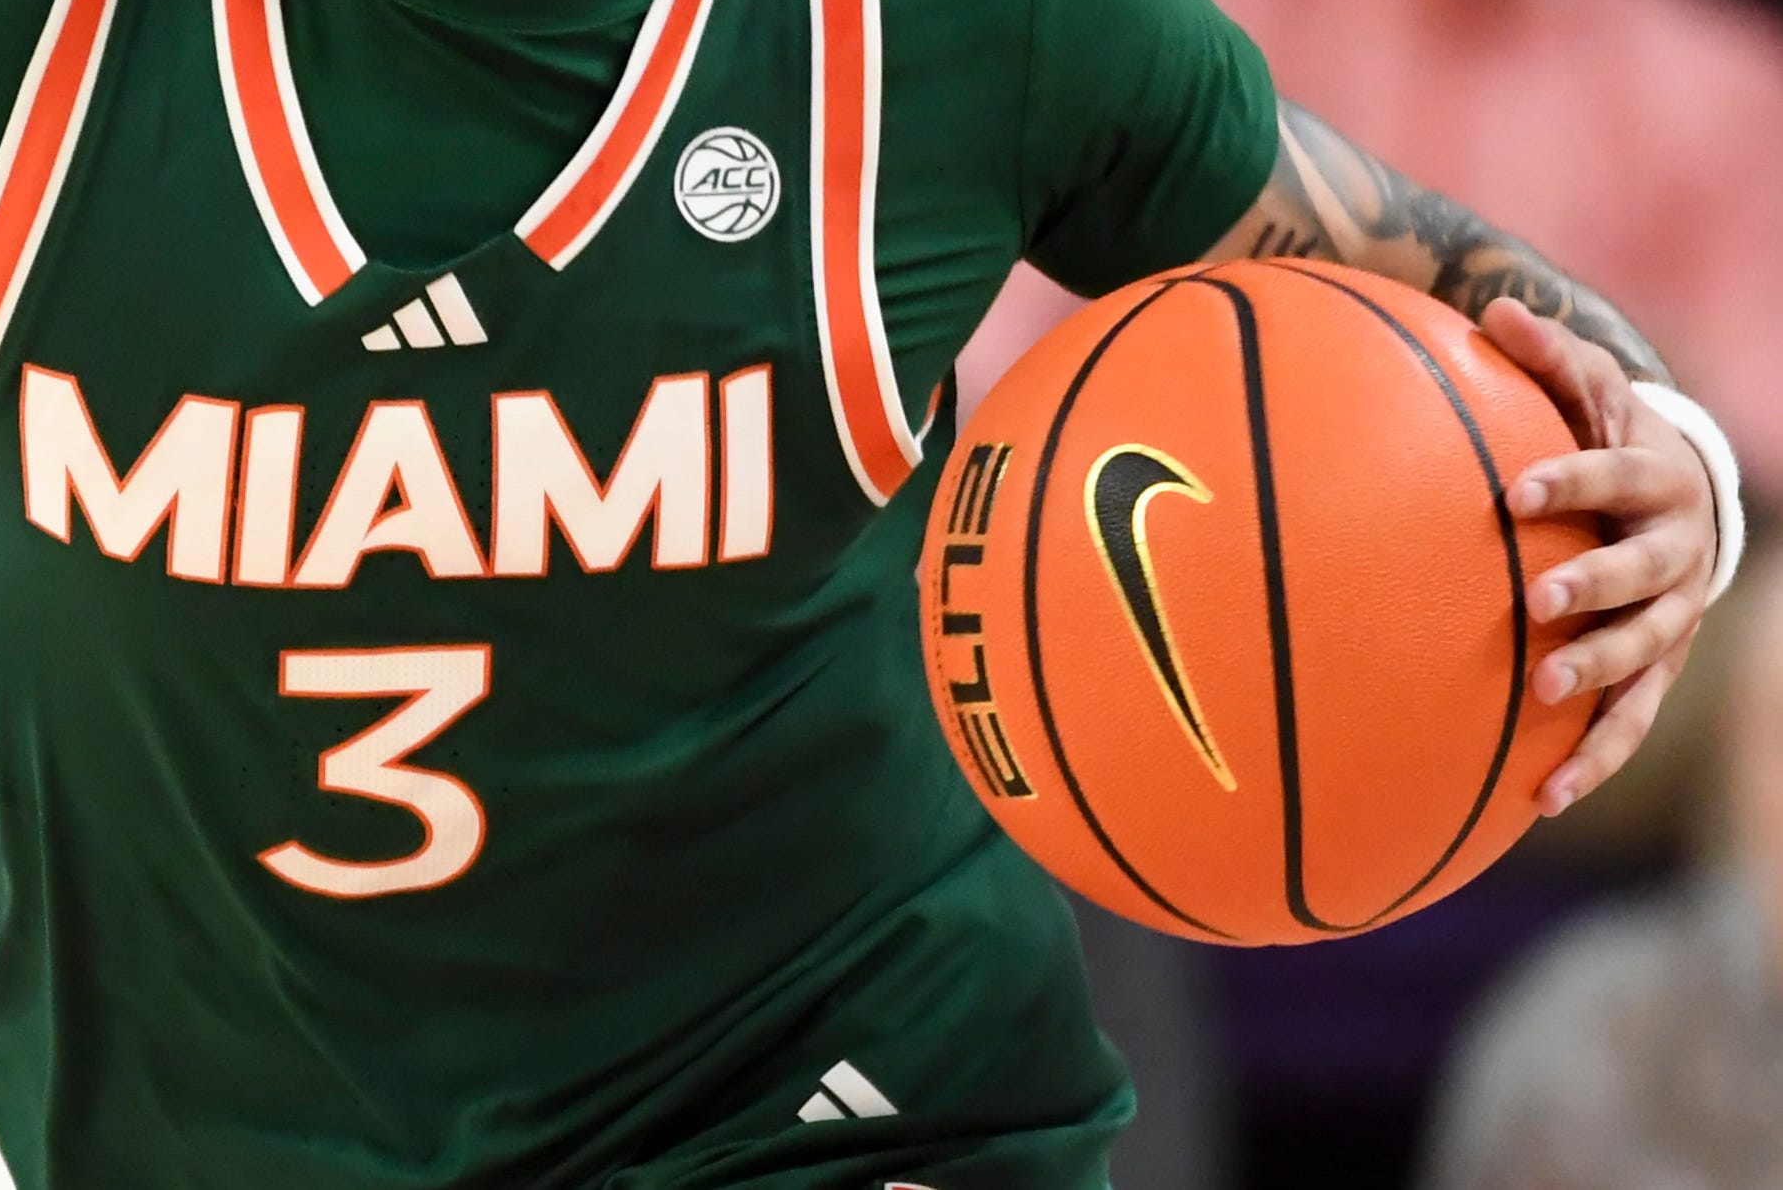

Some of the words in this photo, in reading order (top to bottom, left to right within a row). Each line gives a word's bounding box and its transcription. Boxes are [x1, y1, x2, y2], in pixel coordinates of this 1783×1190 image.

[690, 166, 768, 191] ACC
[19, 363, 775, 590] MIAMI
[939, 441, 1039, 800] ELITE
[257, 643, 493, 900] 3
